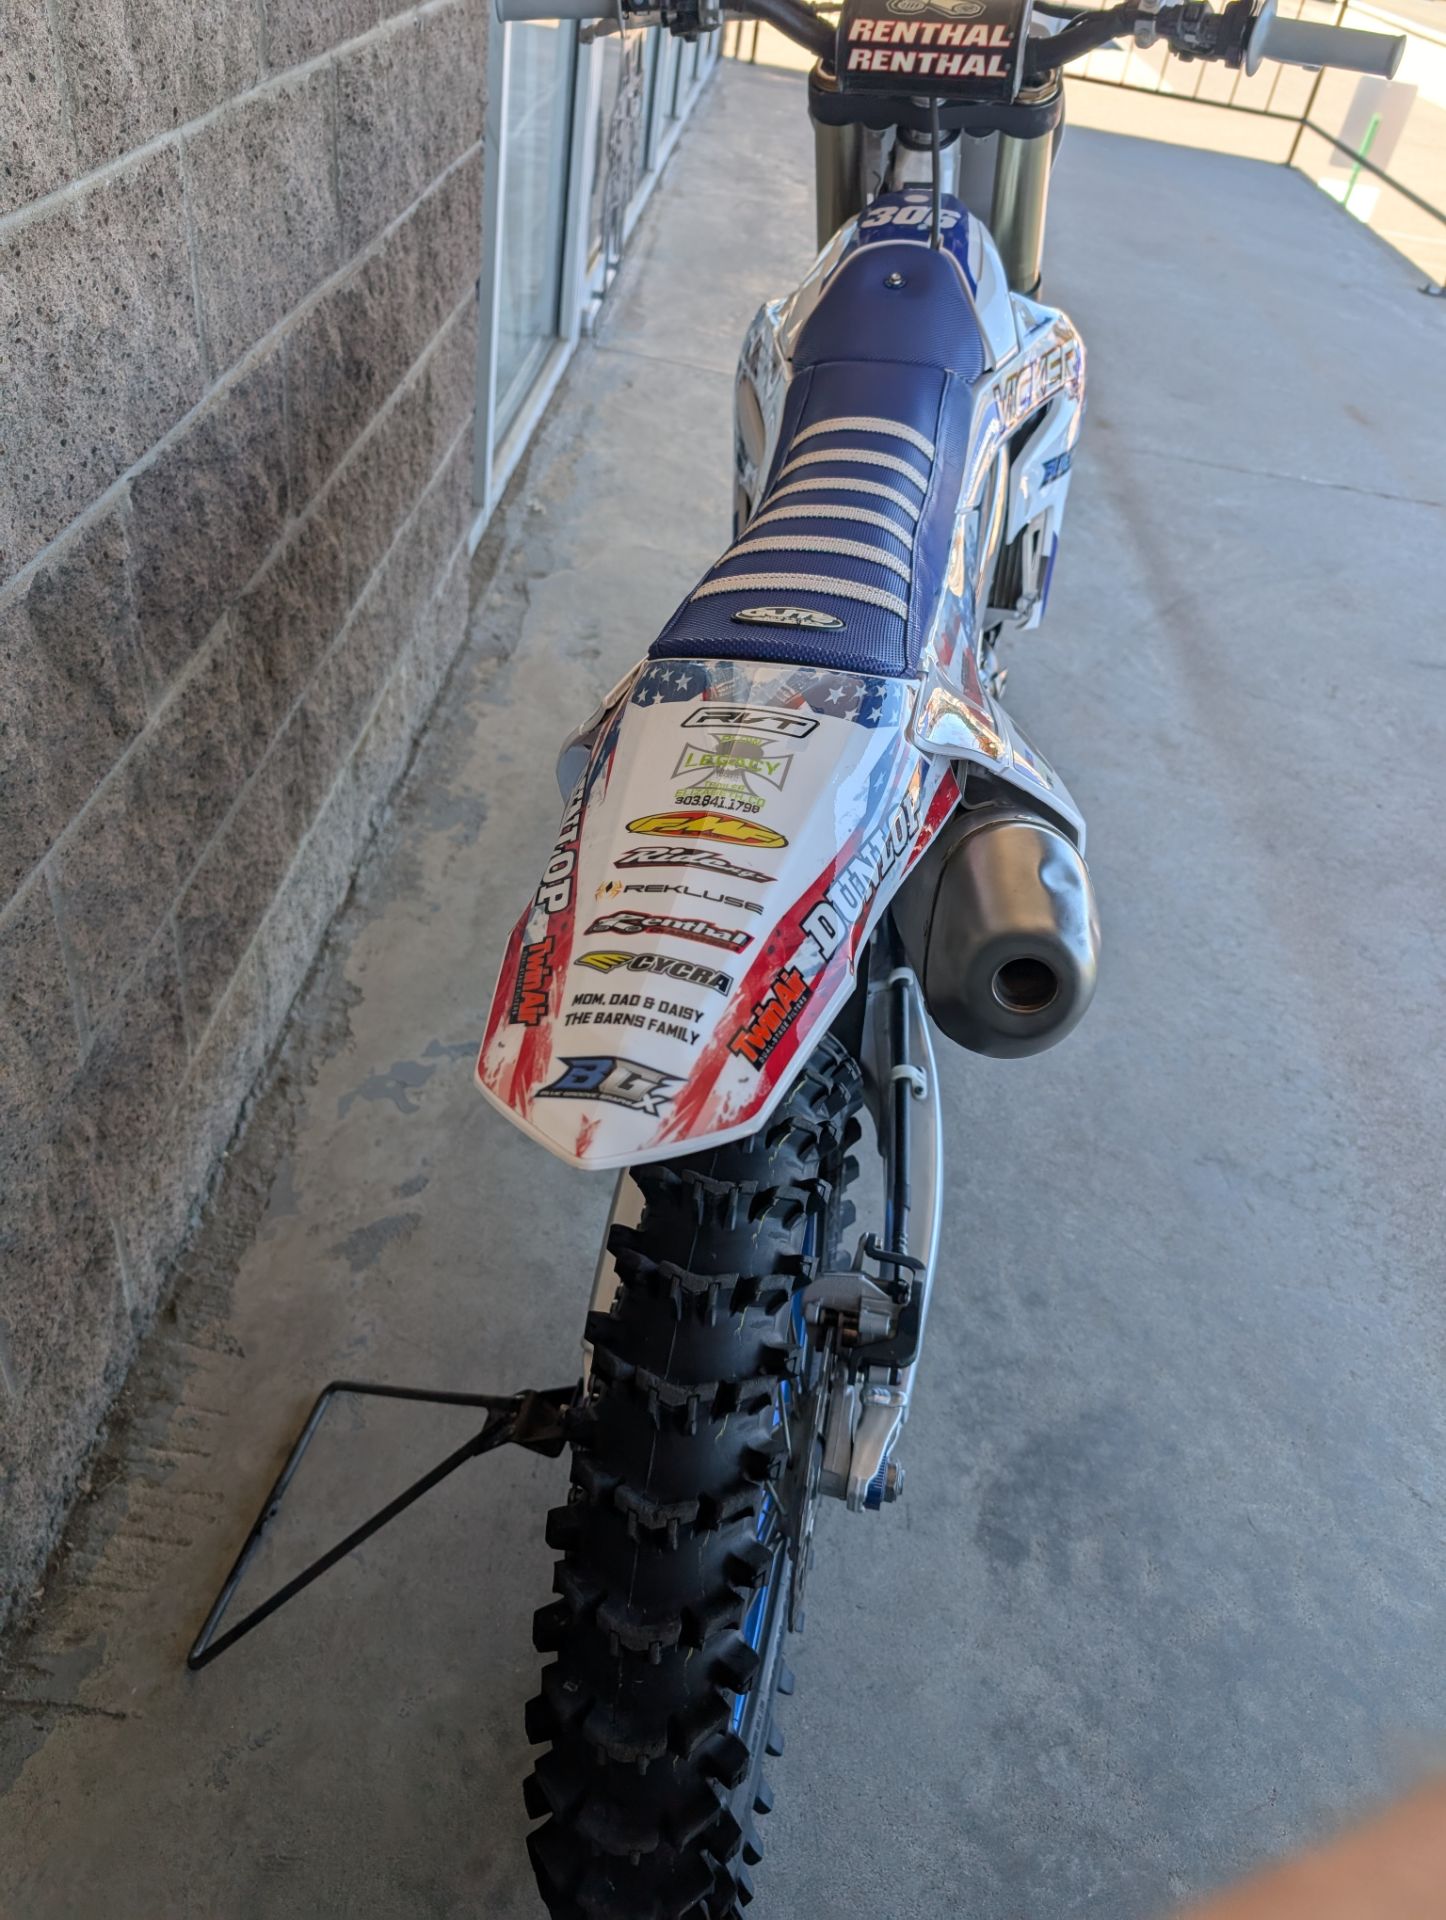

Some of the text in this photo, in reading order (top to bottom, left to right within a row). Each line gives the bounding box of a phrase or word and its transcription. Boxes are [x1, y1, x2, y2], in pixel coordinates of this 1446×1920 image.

[848, 18, 1011, 47] RENTHAL
[847, 48, 1008, 77] RENTHAL
[861, 205, 961, 229] 306
[684, 753, 780, 776] LEGACY
[630, 813, 787, 847] FMF
[799, 784, 921, 963] DUNLOP
[624, 884, 764, 915] REKLUSE
[631, 955, 732, 994] CYCRA
[609, 994, 641, 1006] DAD
[643, 997, 655, 1009] &
[657, 1000, 704, 1023] DAISY
[565, 1012, 700, 1046] THE BARNS FAMILY
